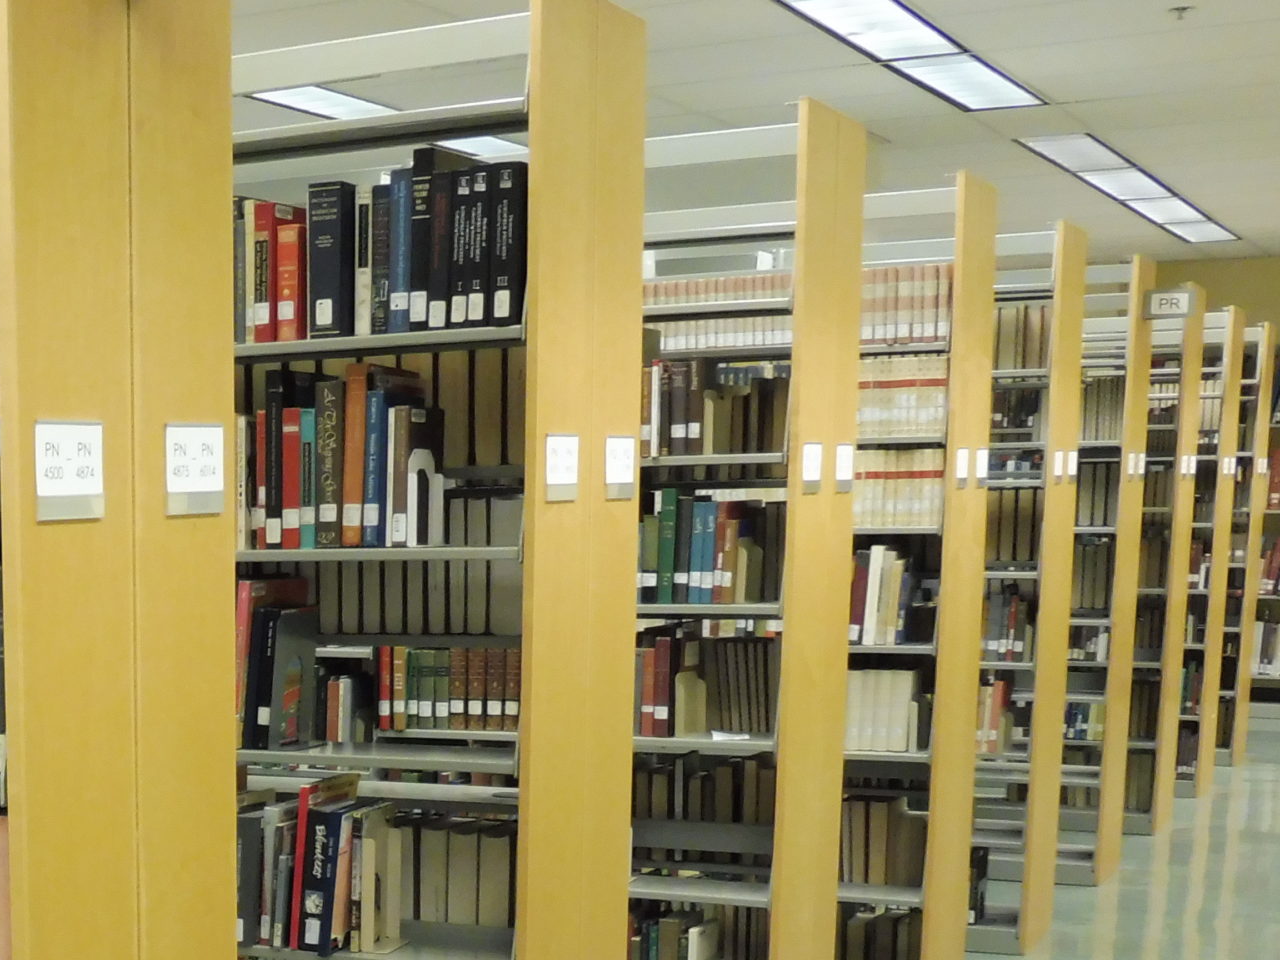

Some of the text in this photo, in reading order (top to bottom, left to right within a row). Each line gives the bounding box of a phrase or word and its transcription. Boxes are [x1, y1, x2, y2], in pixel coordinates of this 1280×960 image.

[1158, 297, 1181, 310] PR
[45, 442, 92, 457] PN PN
[173, 443, 214, 457] PN PN
[44, 466, 95, 480] 4500 4874
